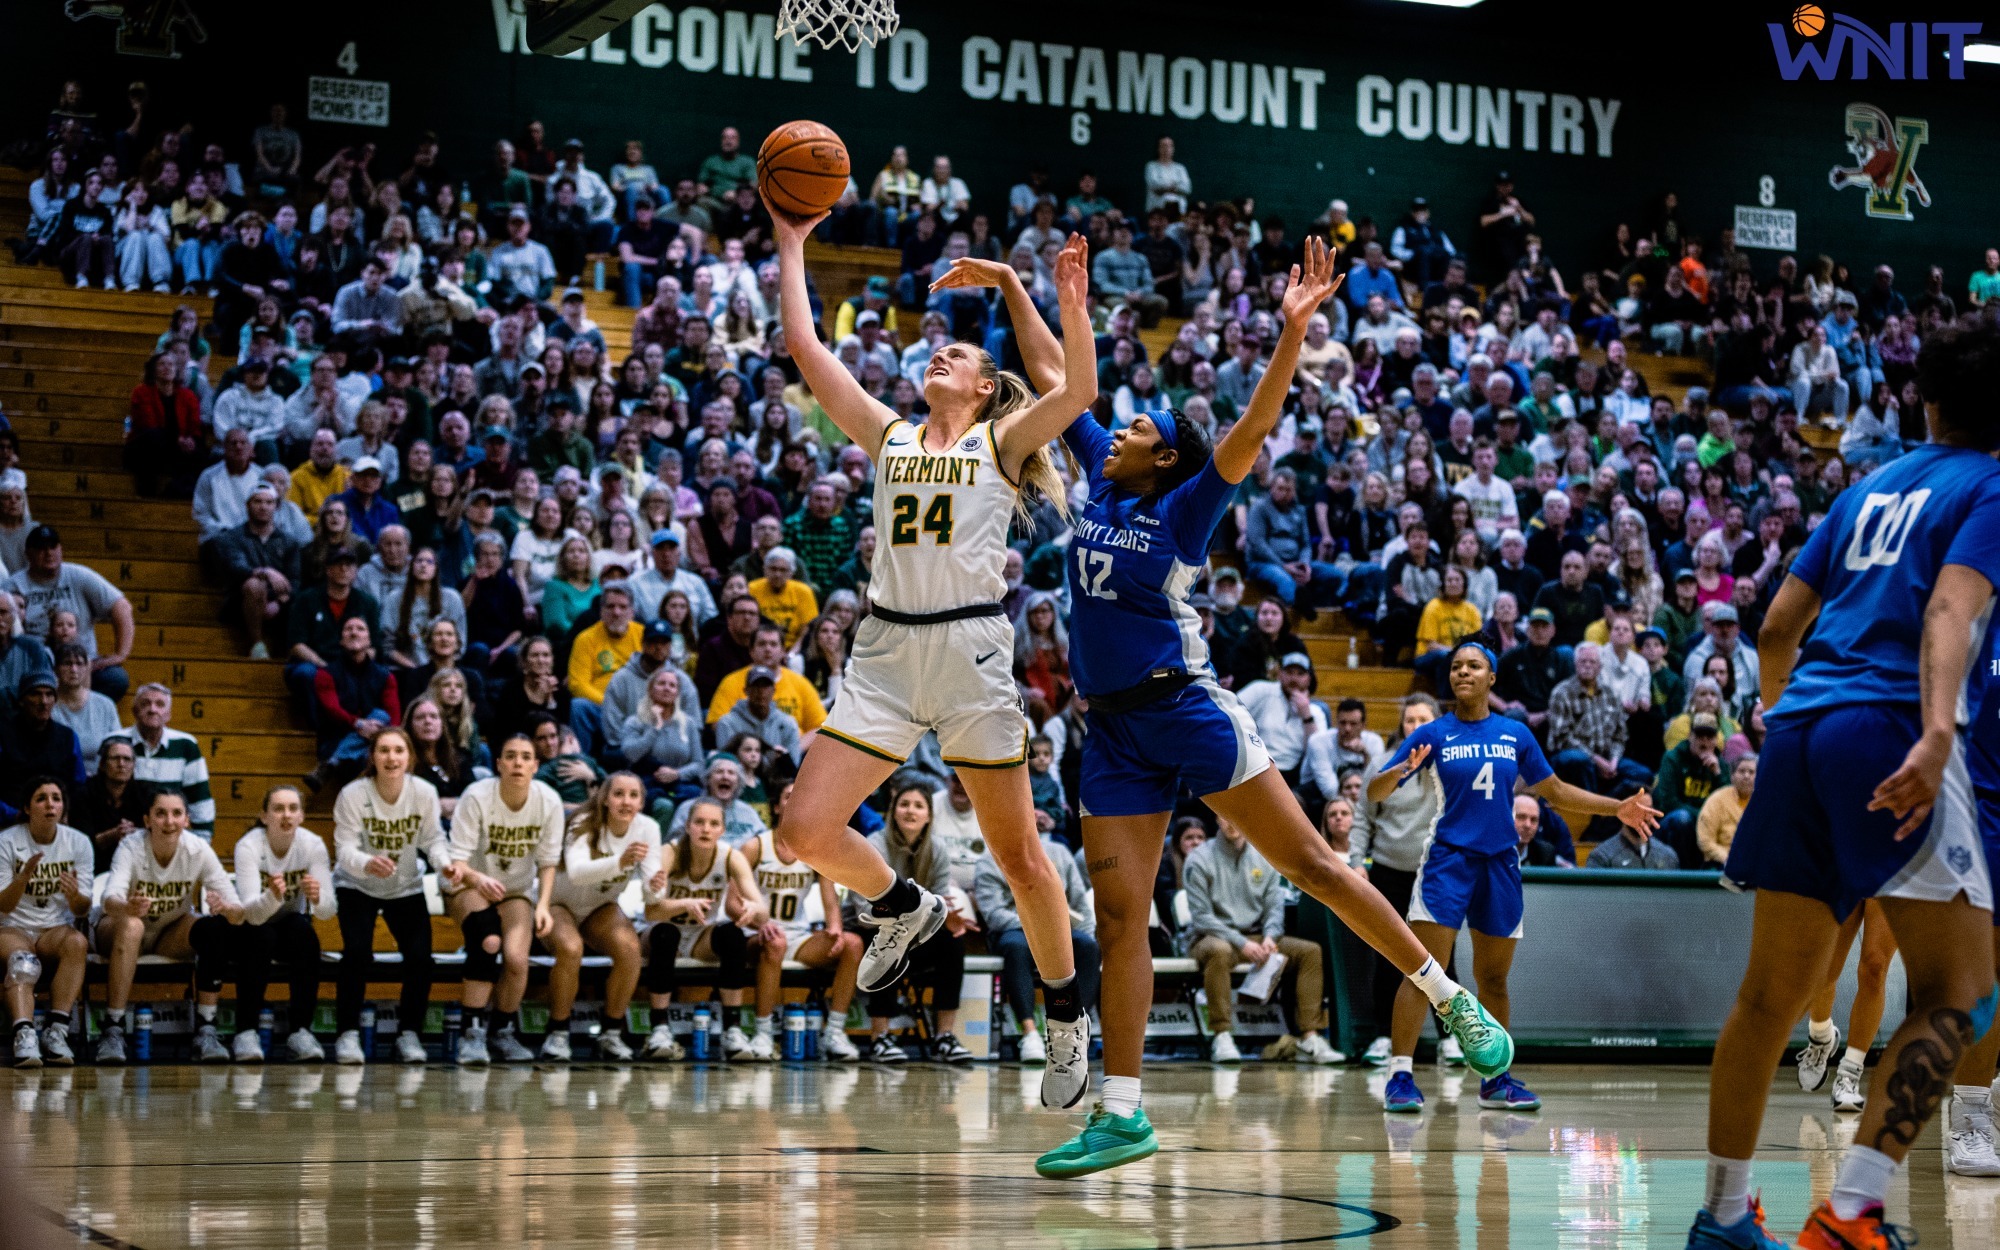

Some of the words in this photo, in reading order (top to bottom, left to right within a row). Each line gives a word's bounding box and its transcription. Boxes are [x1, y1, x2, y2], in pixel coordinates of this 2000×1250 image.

[336, 41, 359, 76] 4
[493, 0, 813, 83] WLCOME
[849, 24, 929, 93] TO
[962, 36, 1325, 131] CATAMOUNT
[1356, 74, 1621, 157] COUNTRY
[312, 80, 385, 102] RESERVED
[312, 98, 354, 118] ROWS
[1071, 112, 1091, 146] 6
[1759, 175, 1776, 207] 8
[885, 455, 980, 487] VERMONT
[891, 492, 955, 547] 24
[1845, 488, 1932, 571] 00
[1075, 517, 1107, 542] AINT
[1103, 527, 1151, 553] LOUIS
[119, 561, 132, 581] K
[1076, 546, 1118, 600] 12
[138, 594, 150, 613] J
[172, 664, 186, 684] H
[191, 700, 205, 719] G
[211, 738, 223, 758] F
[1442, 744, 1480, 762] SAINT
[1483, 743, 1516, 762] LOUIS
[231, 779, 243, 799] E
[1472, 761, 1495, 800] 4
[369, 832, 415, 850] ENERY
[488, 825, 541, 842] ERMONT
[486, 841, 535, 858] NERGY
[136, 880, 192, 899] ERMONT
[758, 871, 814, 889] VERMONT
[770, 893, 797, 920] 10
[1148, 1010, 1188, 1024] Bank
[1237, 1010, 1280, 1024] Bank
